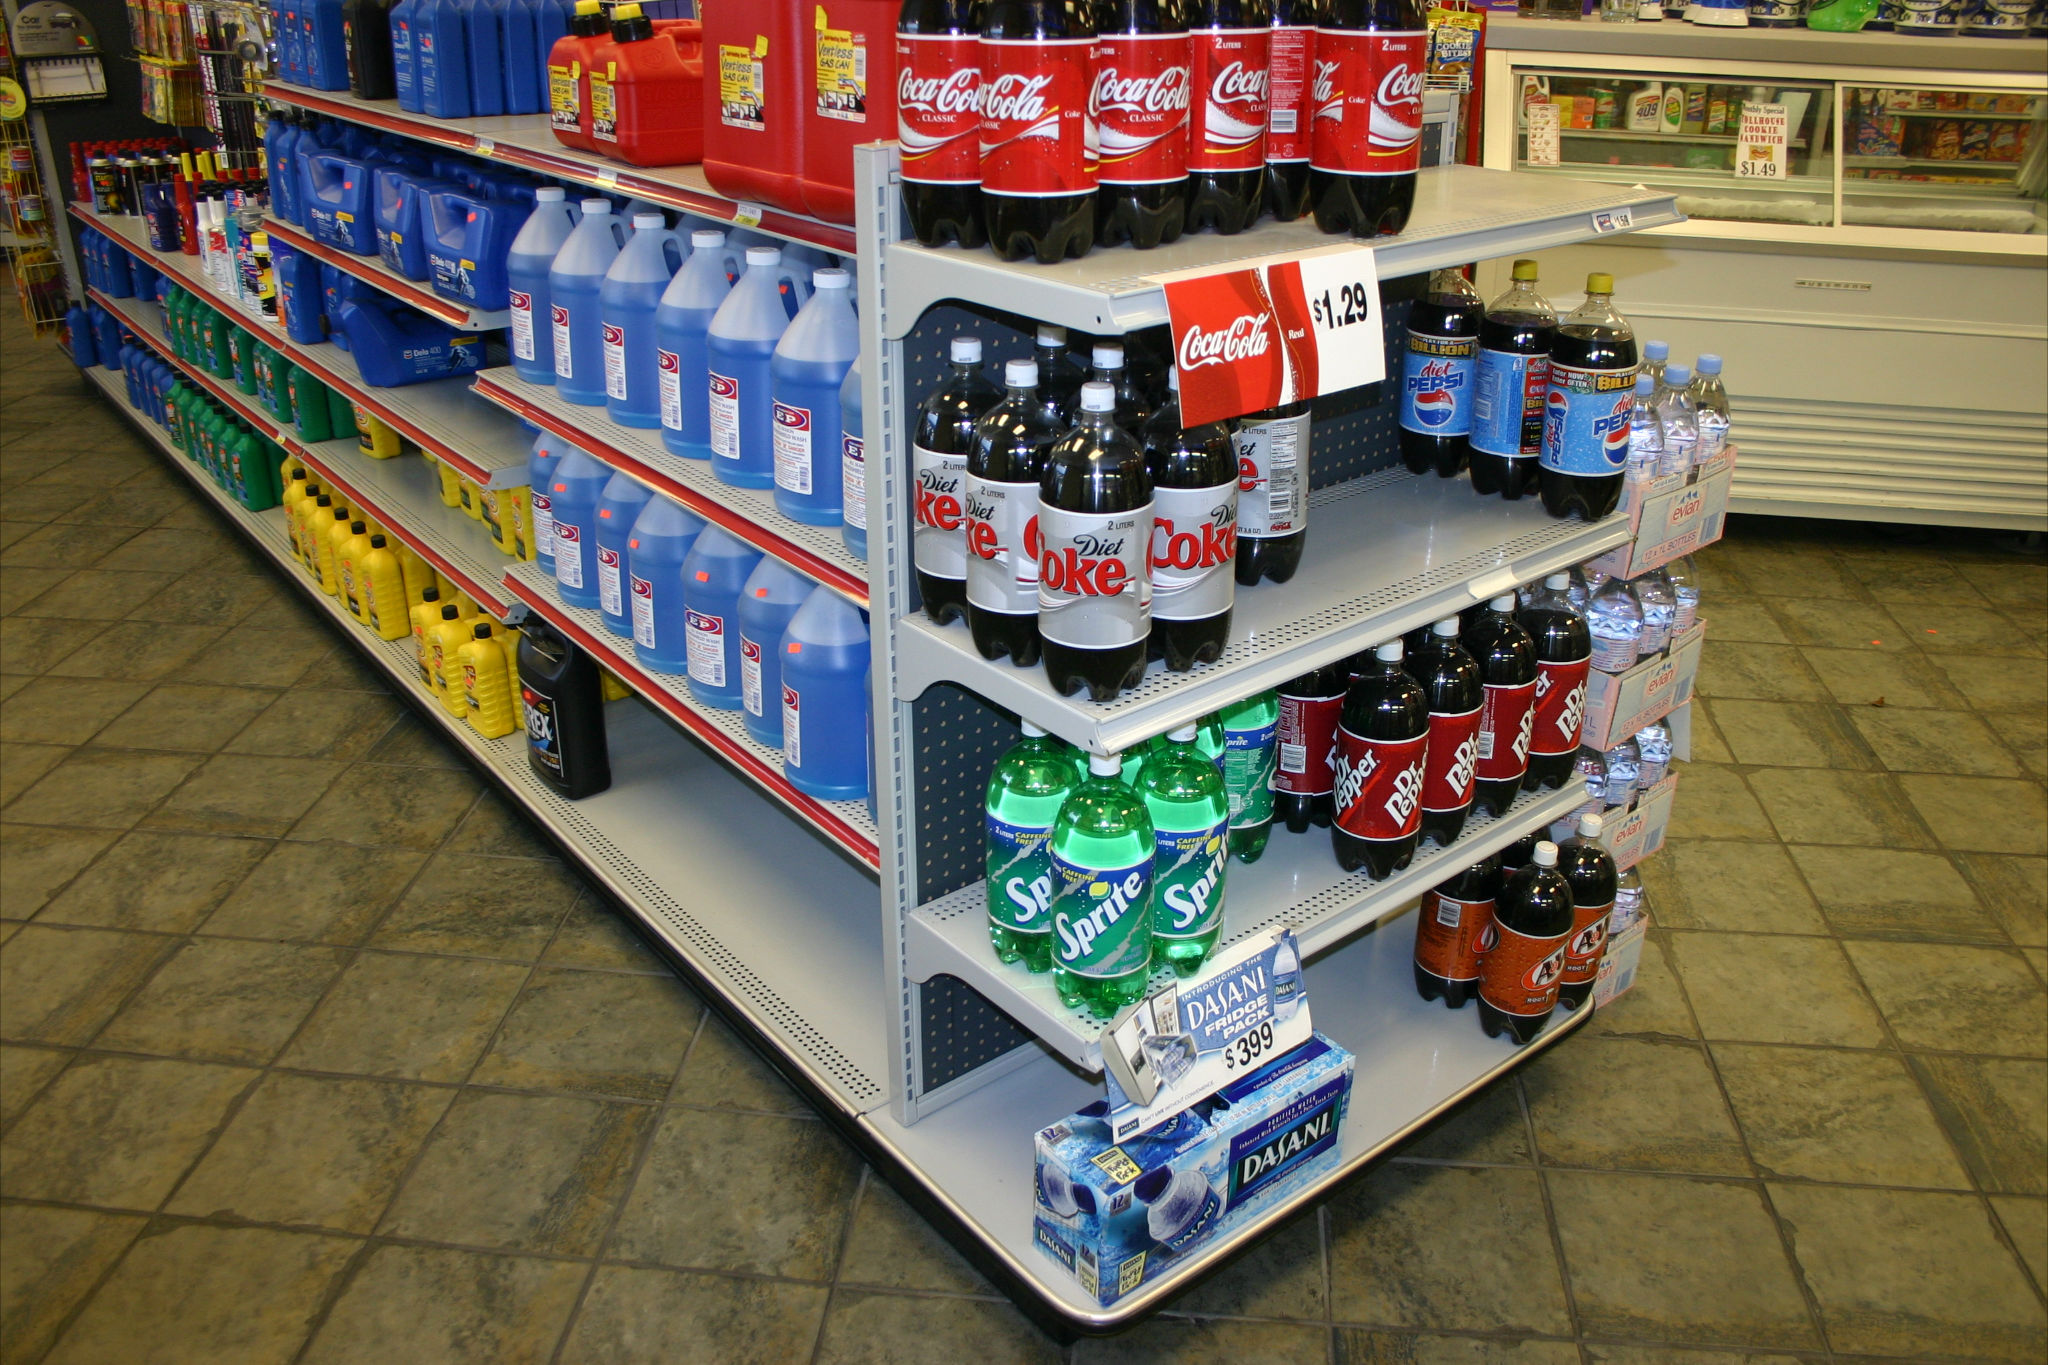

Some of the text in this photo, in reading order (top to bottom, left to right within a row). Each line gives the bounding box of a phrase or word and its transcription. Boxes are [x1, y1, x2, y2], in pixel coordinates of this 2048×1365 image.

[818, 44, 853, 59] Ventless
[1215, 37, 1223, 49] 2
[1382, 39, 1389, 51] 2
[820, 58, 850, 69] GAS CAN
[723, 72, 750, 83] GAS CAN
[1348, 96, 1366, 104] Coke
[922, 113, 957, 123] CLASSIC
[1064, 110, 1081, 118] Coke
[1129, 113, 1164, 123] CLASSIC
[1636, 102, 1659, 118] 409
[1763, 105, 1785, 114] Special
[1744, 125, 1778, 134] COOKIE
[1741, 160, 1776, 178] $1.49
[1179, 281, 1368, 371] Coca-Cola Real $1.29
[1411, 338, 1471, 356] BILLION
[1421, 360, 1454, 377] diet
[1408, 371, 1464, 392] PEPSI
[1594, 409, 1632, 436] PEP
[1552, 414, 1563, 465] PEPSI
[1240, 442, 1256, 456] et
[943, 460, 948, 470] 2
[920, 468, 958, 494] Diet
[981, 485, 1005, 499] 2 LITERS
[916, 480, 962, 532] ke
[1672, 499, 1700, 521] evian
[1108, 520, 1135, 531] 2 LITERS
[1073, 533, 1124, 556] Diet
[1648, 669, 1674, 692] evian
[1565, 680, 1583, 714] Dr
[1454, 732, 1474, 768] Dr
[1334, 748, 1377, 817] Pepper
[1393, 760, 1418, 798] Dr
[1616, 820, 1643, 842] evian
[1062, 867, 1096, 881] CAFFEINE
[1062, 872, 1078, 883] FREE
[1056, 872, 1143, 962] Sprite
[1182, 954, 1262, 1001] INTRODUCING THE
[1275, 981, 1296, 995] DASANI
[1186, 966, 1267, 1031] DASANI
[1204, 993, 1268, 1037] FRIDGE
[1222, 1005, 1270, 1040] PACK
[1243, 1112, 1328, 1184] DASANI
[1112, 1193, 1125, 1211] 12
[1173, 1201, 1215, 1247] DASANI
[1039, 1227, 1072, 1266] DASANI
